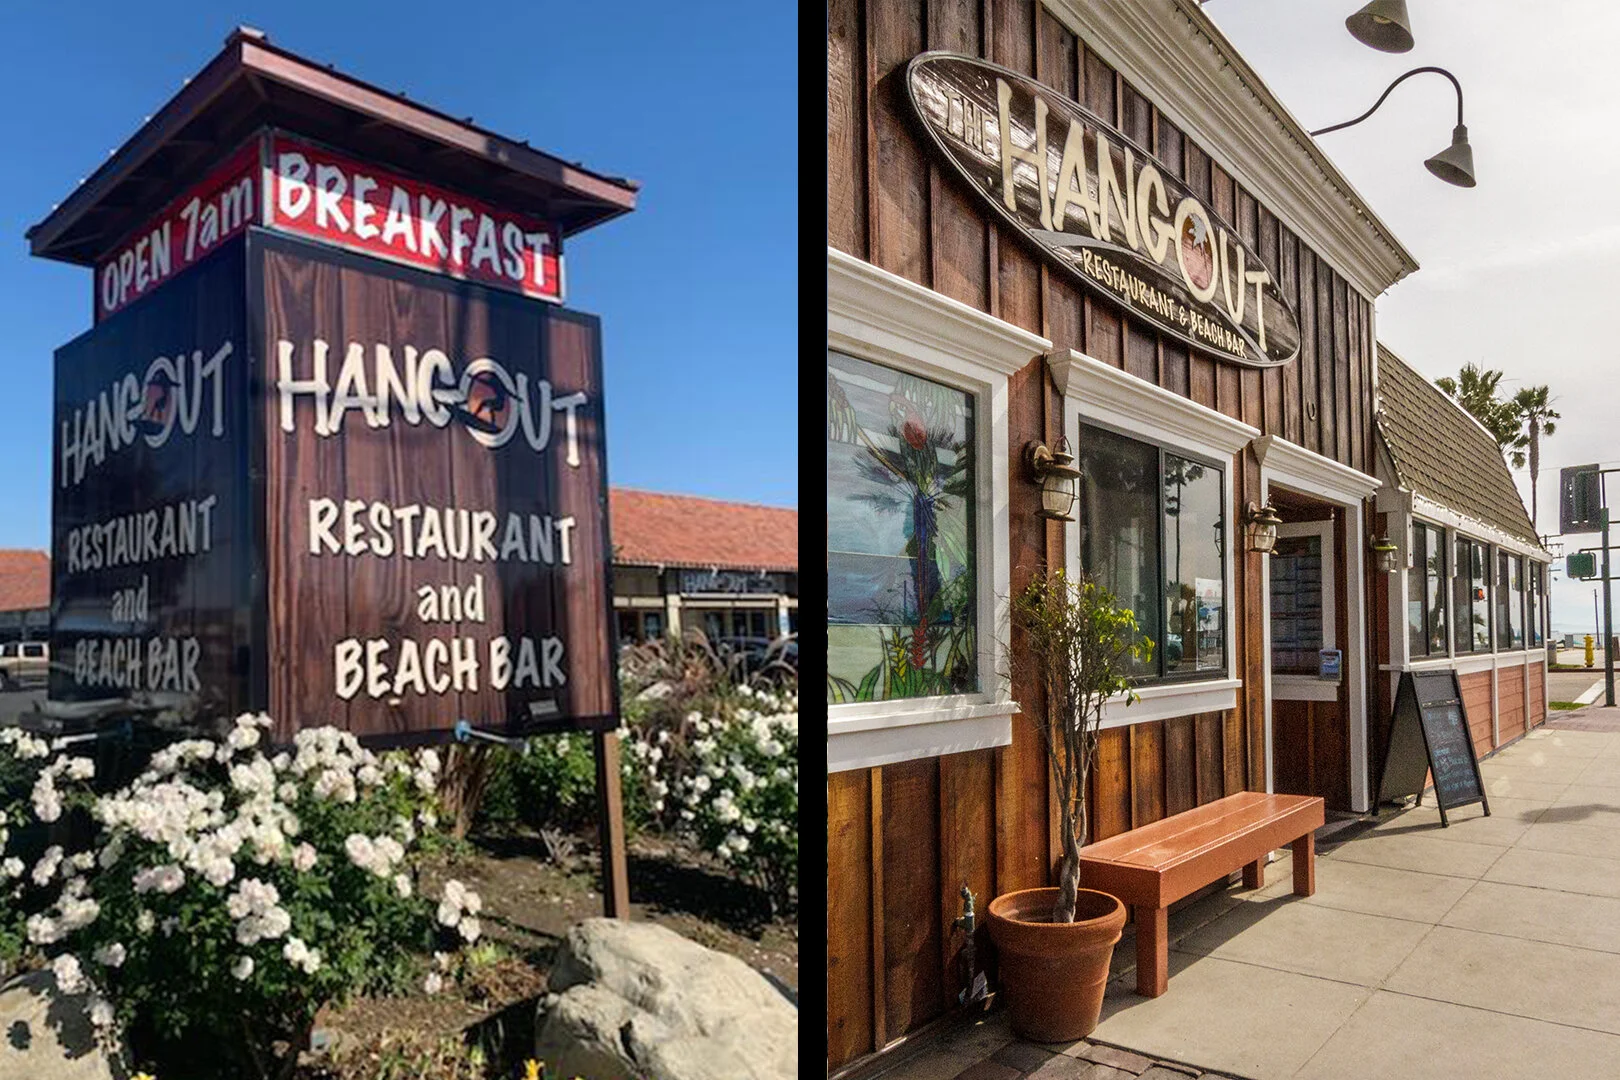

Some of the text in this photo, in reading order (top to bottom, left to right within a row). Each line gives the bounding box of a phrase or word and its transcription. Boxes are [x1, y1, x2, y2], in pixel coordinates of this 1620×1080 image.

[102, 177, 253, 311] OPEN 7am
[277, 152, 550, 288] BREAKFAST
[943, 76, 1271, 353] THE HANGOUT
[1081, 246, 1248, 360] RESTAURANT & BEACH BAR
[59, 341, 234, 488] HANGOUT
[276, 339, 588, 468] HANGOUT
[67, 494, 217, 574] RESTAURANT
[308, 498, 576, 565] RESTAURANT
[111, 574, 149, 623] and
[416, 573, 485, 623] and
[74, 636, 201, 693] BEACH BAR
[334, 636, 567, 699] BEACH BAR
